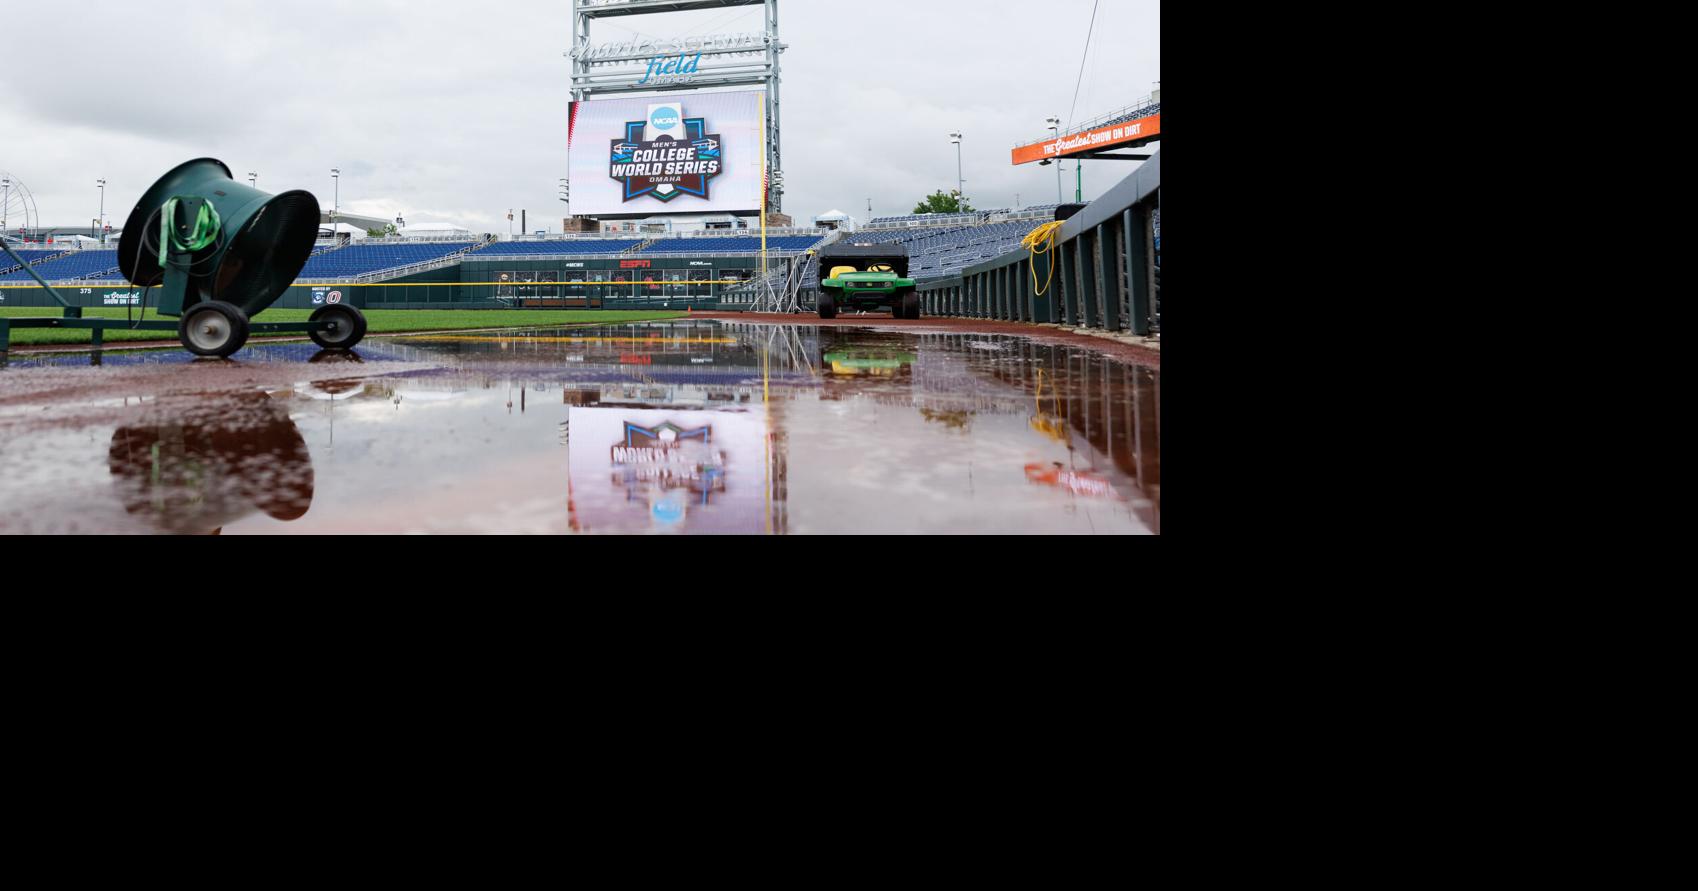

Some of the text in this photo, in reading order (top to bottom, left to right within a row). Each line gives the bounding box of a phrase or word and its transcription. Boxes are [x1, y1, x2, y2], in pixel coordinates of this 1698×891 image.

[637, 51, 702, 84] field
[653, 116, 679, 126] NCAA
[651, 141, 678, 149] MEN'S
[1043, 123, 1141, 155] THE Greatest SHOW ON DIRT
[632, 147, 696, 163] COLLEGE
[611, 160, 719, 177] WORLD SERIES
[649, 175, 682, 183] OMAHA
[619, 259, 651, 269] ESPN
